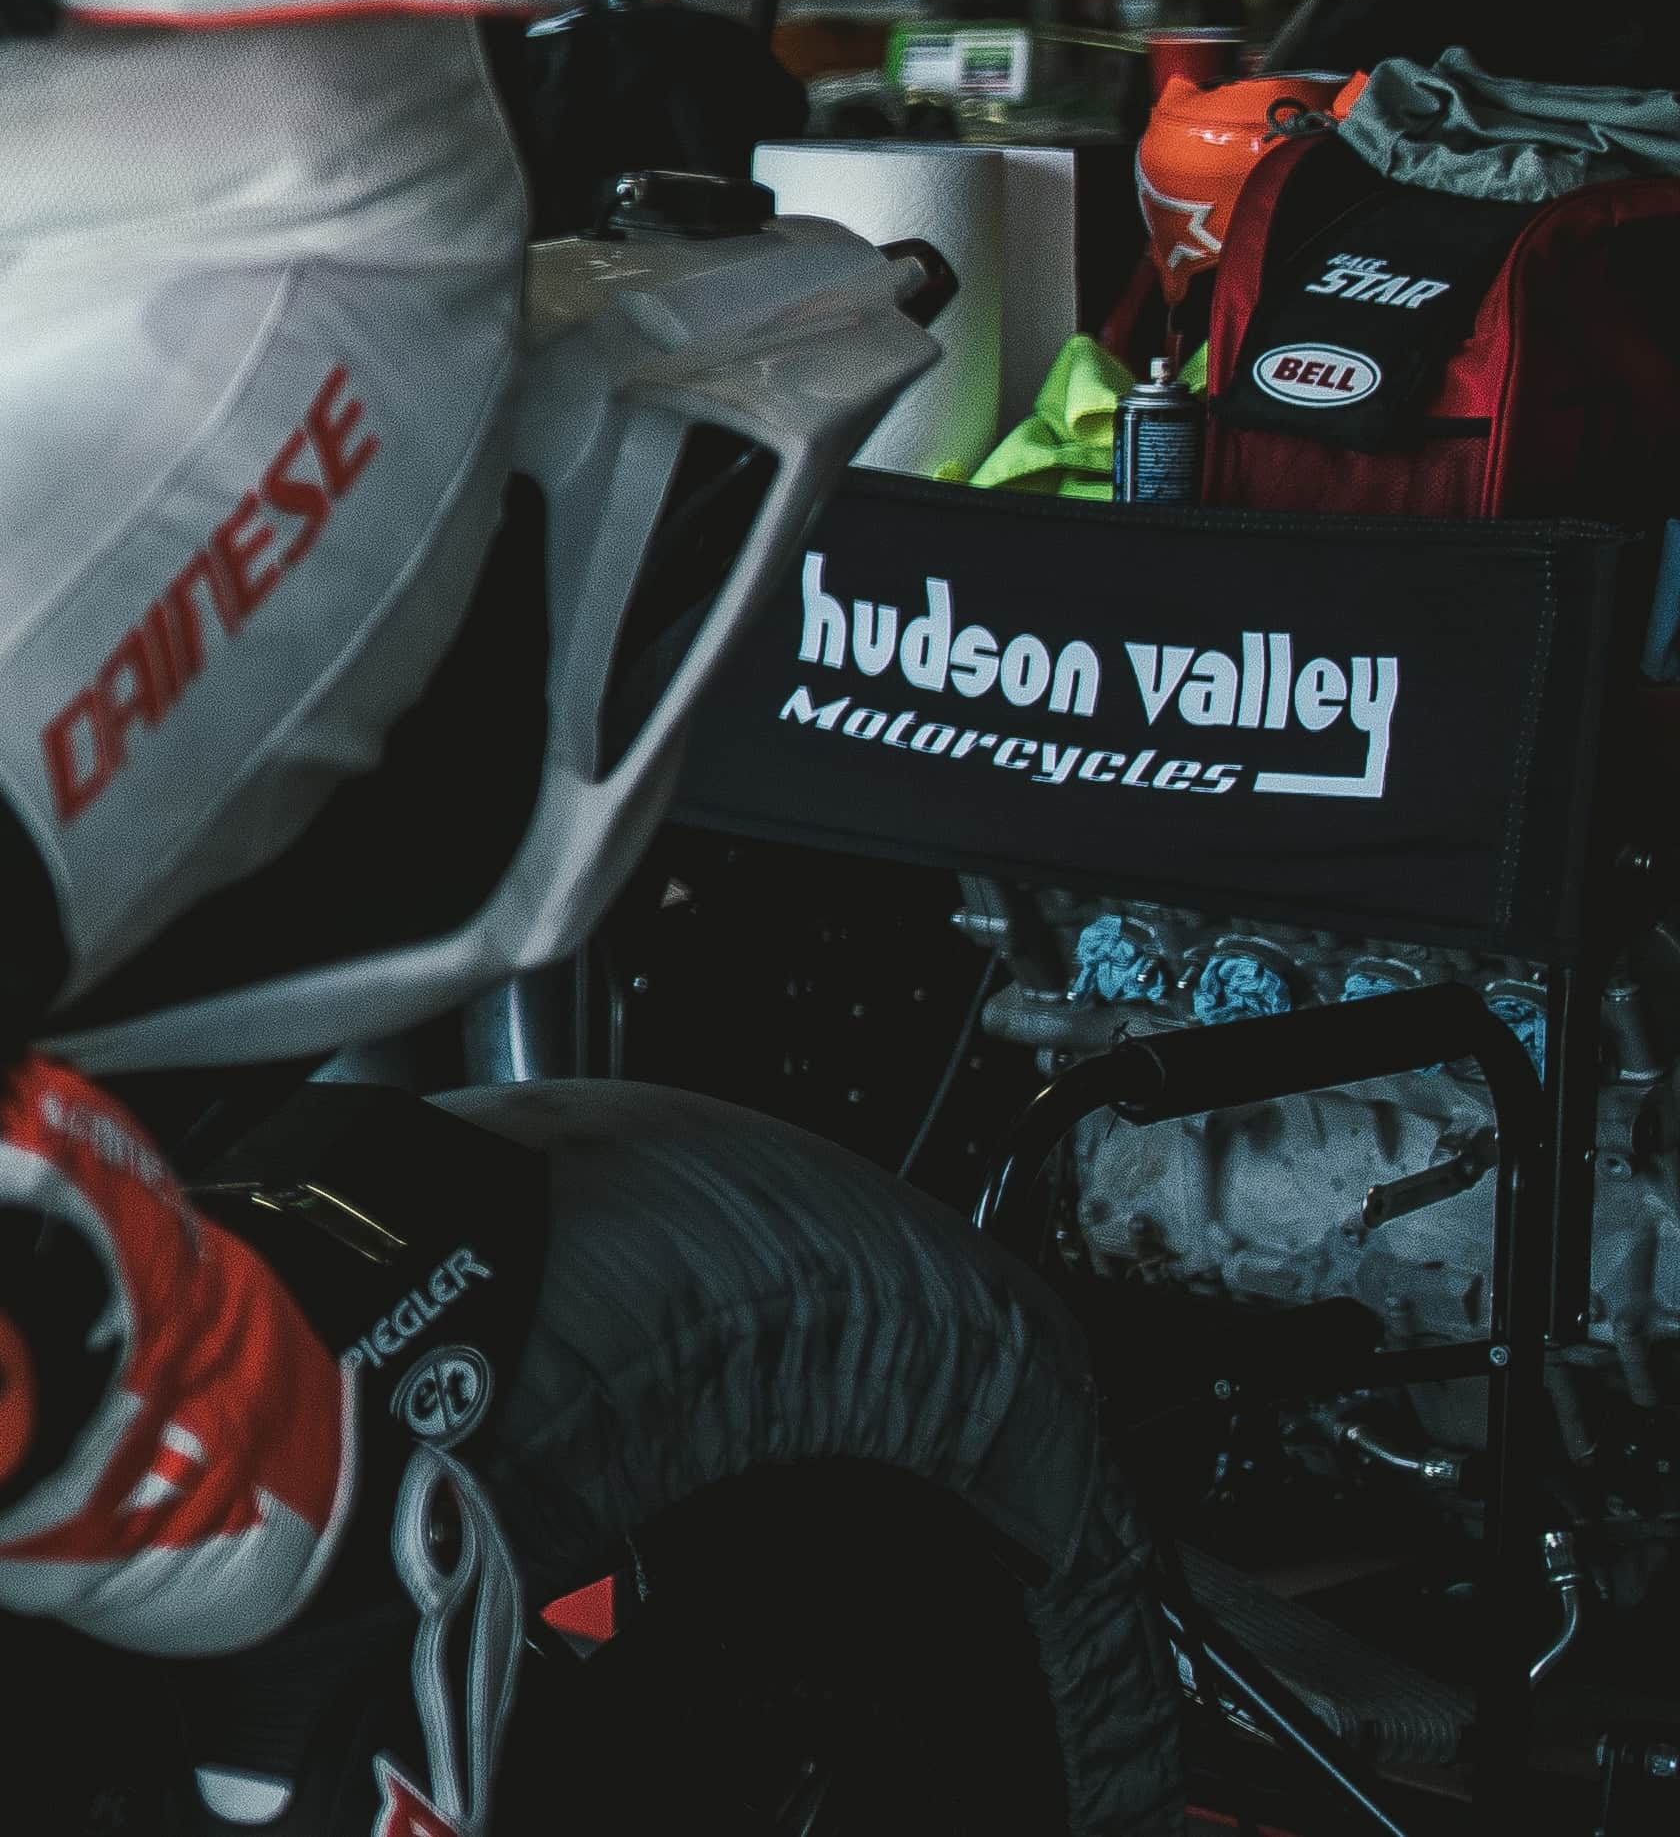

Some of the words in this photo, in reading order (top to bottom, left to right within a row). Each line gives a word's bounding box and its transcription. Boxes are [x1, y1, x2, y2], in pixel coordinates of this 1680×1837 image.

[1303, 267, 1451, 309] STAR
[1271, 356, 1357, 393] BELL
[40, 361, 381, 827] DAINESE
[797, 550, 1100, 717] hudson
[1123, 630, 1399, 799] valley
[777, 684, 1244, 795] Motorcycles
